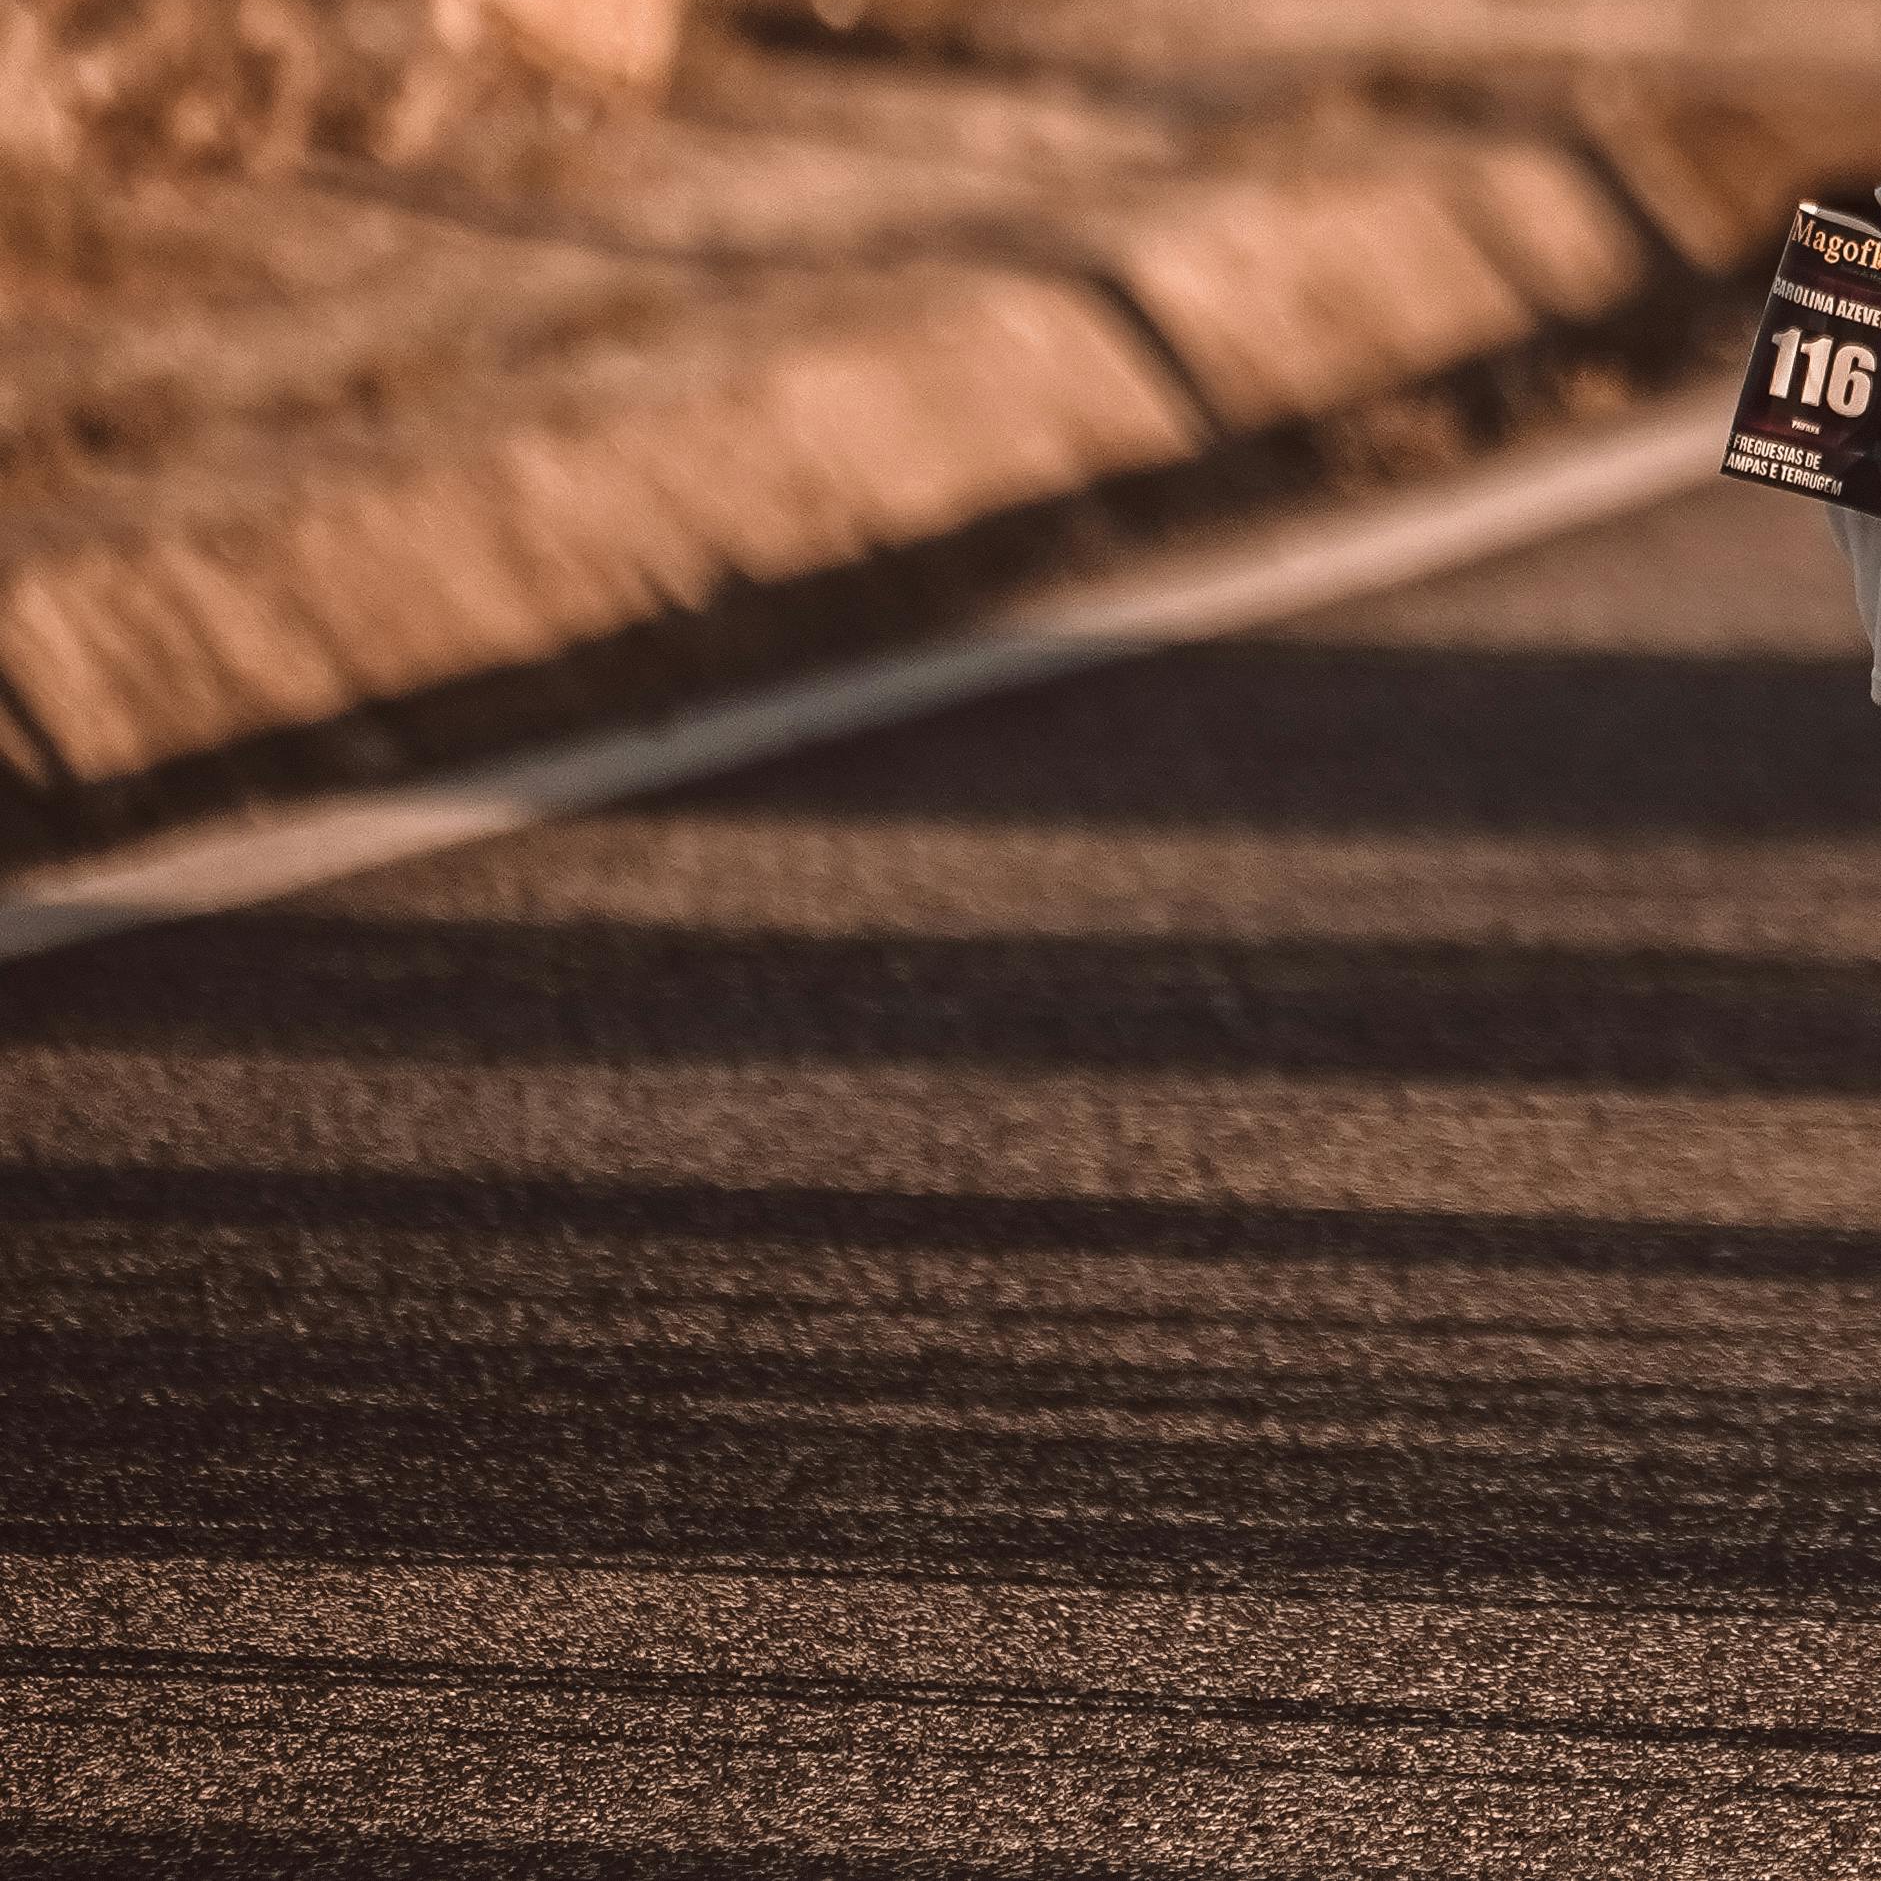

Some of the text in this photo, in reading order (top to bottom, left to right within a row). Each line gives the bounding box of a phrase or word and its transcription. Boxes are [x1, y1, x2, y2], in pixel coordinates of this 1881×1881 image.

[1772, 278, 1834, 316] CAROLINA
[1769, 326, 1877, 418] 116
[1733, 435, 1804, 465] FREGUESIAS
[1805, 452, 1822, 470] DE
[1726, 453, 1842, 497] AMPAS E TERRUGEM
